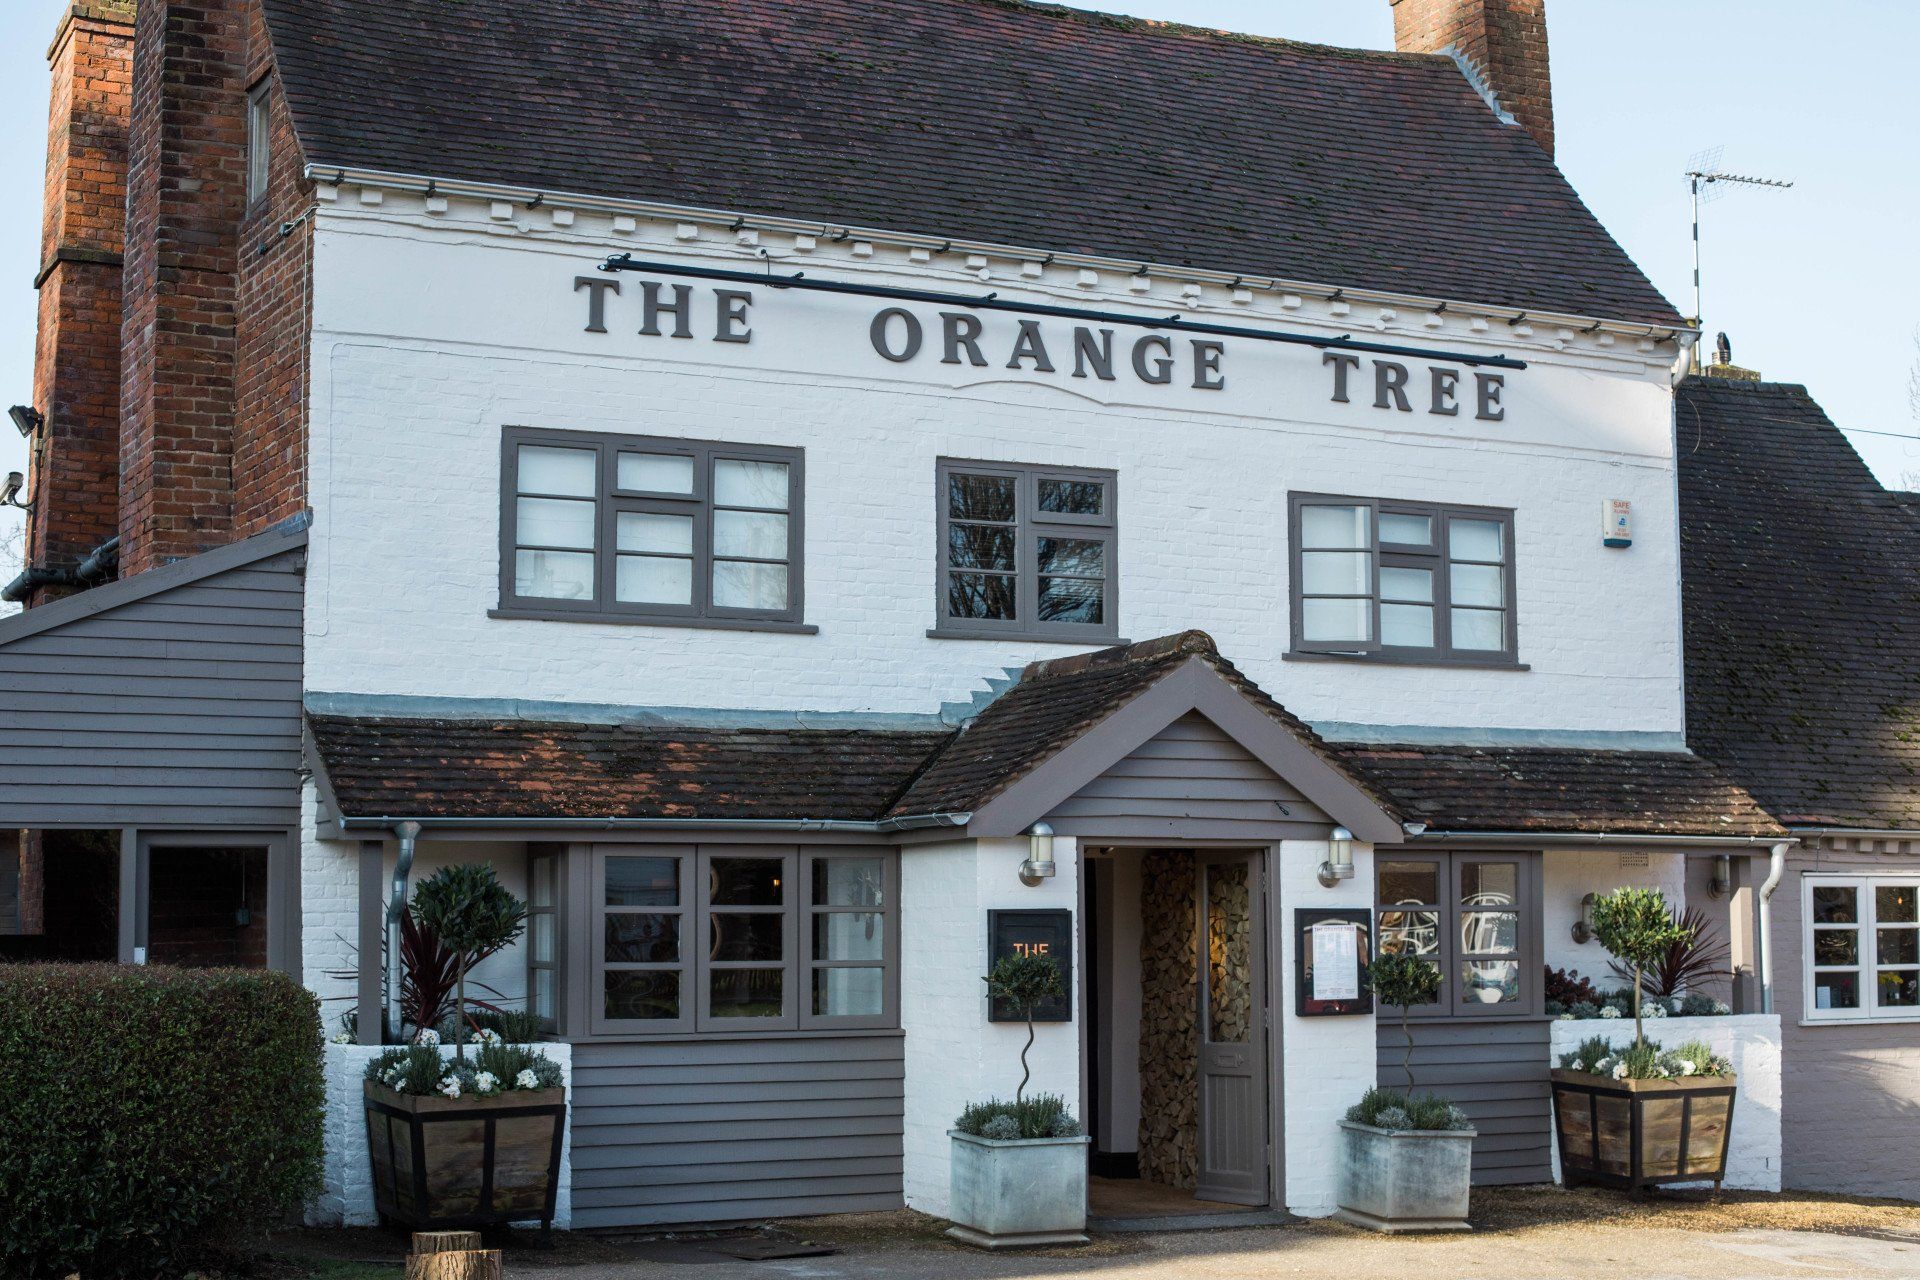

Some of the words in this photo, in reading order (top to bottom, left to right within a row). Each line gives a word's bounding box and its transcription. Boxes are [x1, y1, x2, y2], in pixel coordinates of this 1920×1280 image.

[573, 275, 753, 345] THE
[869, 306, 1225, 391] ORANGE
[1322, 351, 1505, 422] TREE
[1013, 943, 1049, 959] THE
